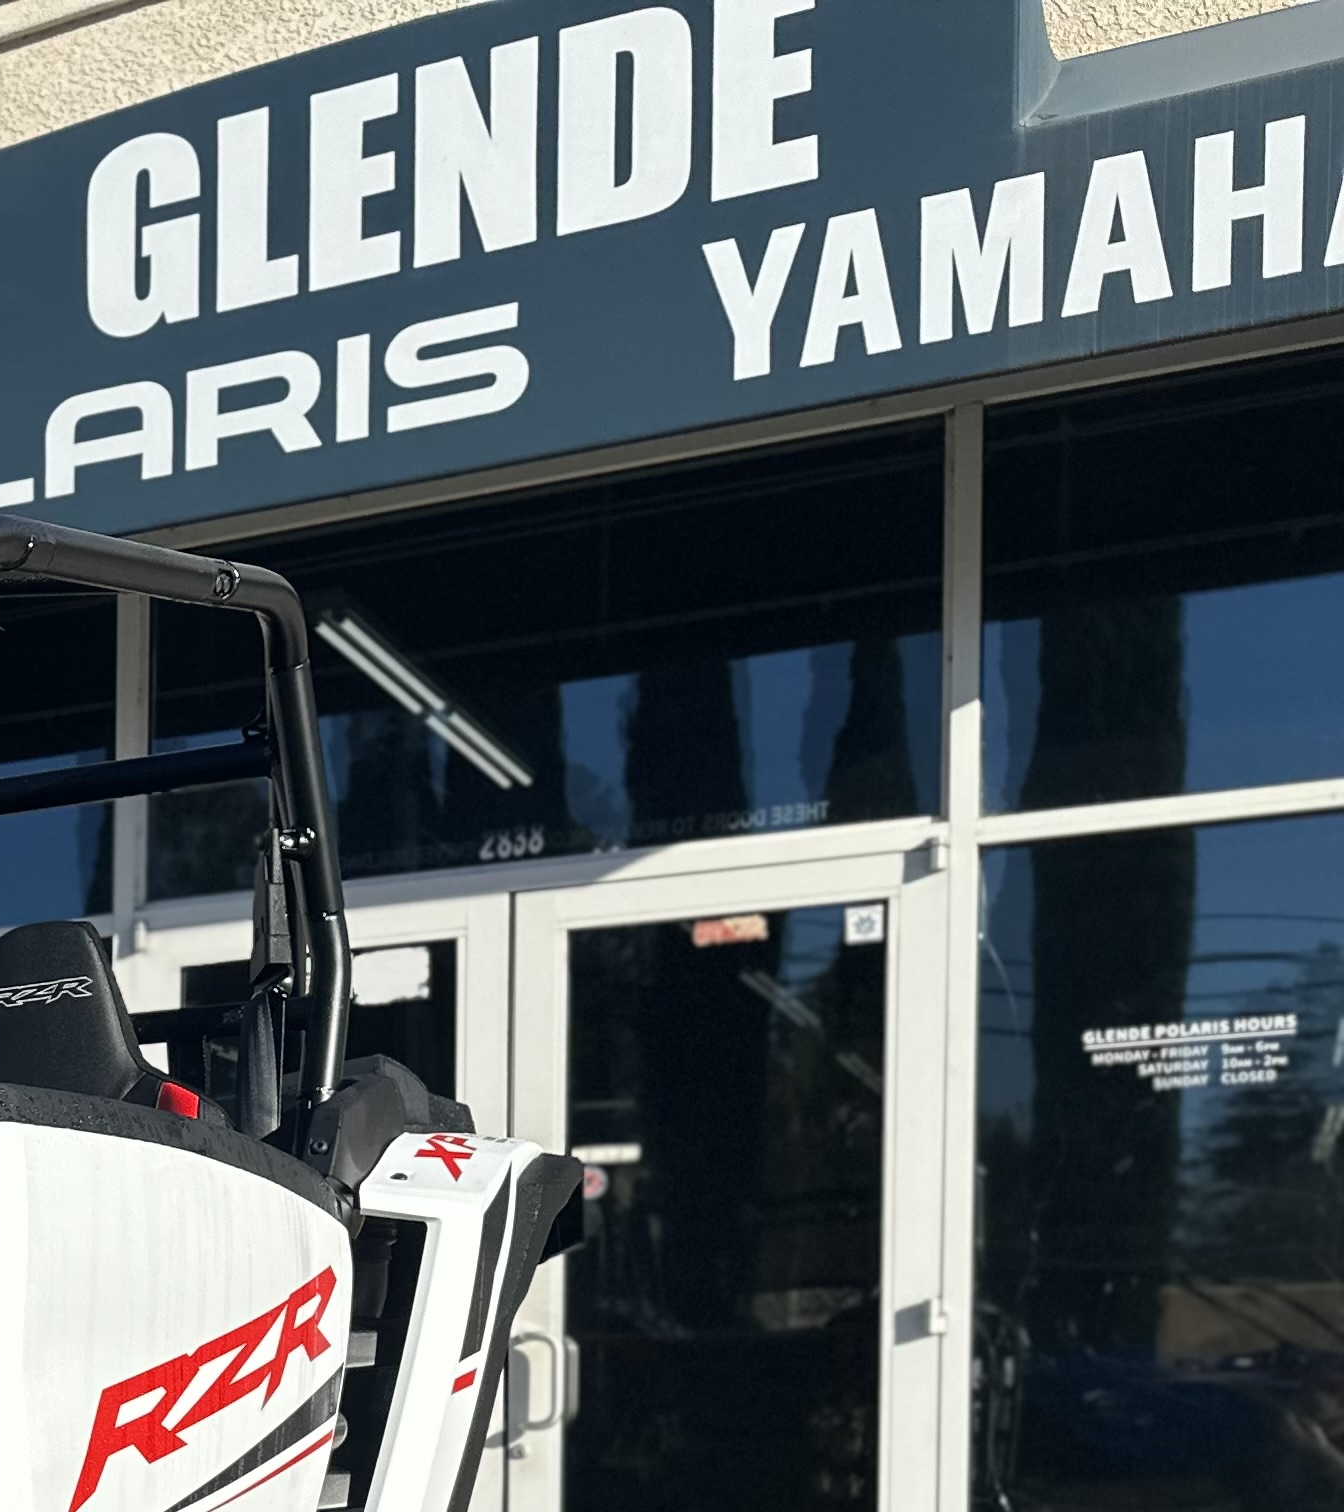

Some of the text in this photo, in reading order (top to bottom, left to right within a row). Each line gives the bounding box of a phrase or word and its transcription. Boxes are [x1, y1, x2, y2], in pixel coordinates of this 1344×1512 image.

[86, 0, 819, 338] GLENDE
[701, 113, 1344, 382] YAMAH
[1083, 1014, 1297, 1045] GLENDE POLARIS HOURS
[1091, 1049, 1150, 1066] MONDAY
[1161, 1045, 1209, 1060] FRIDAY
[1137, 1059, 1209, 1077] SATURDAY
[1152, 1070, 1278, 1092] SUNDAY CLOSED
